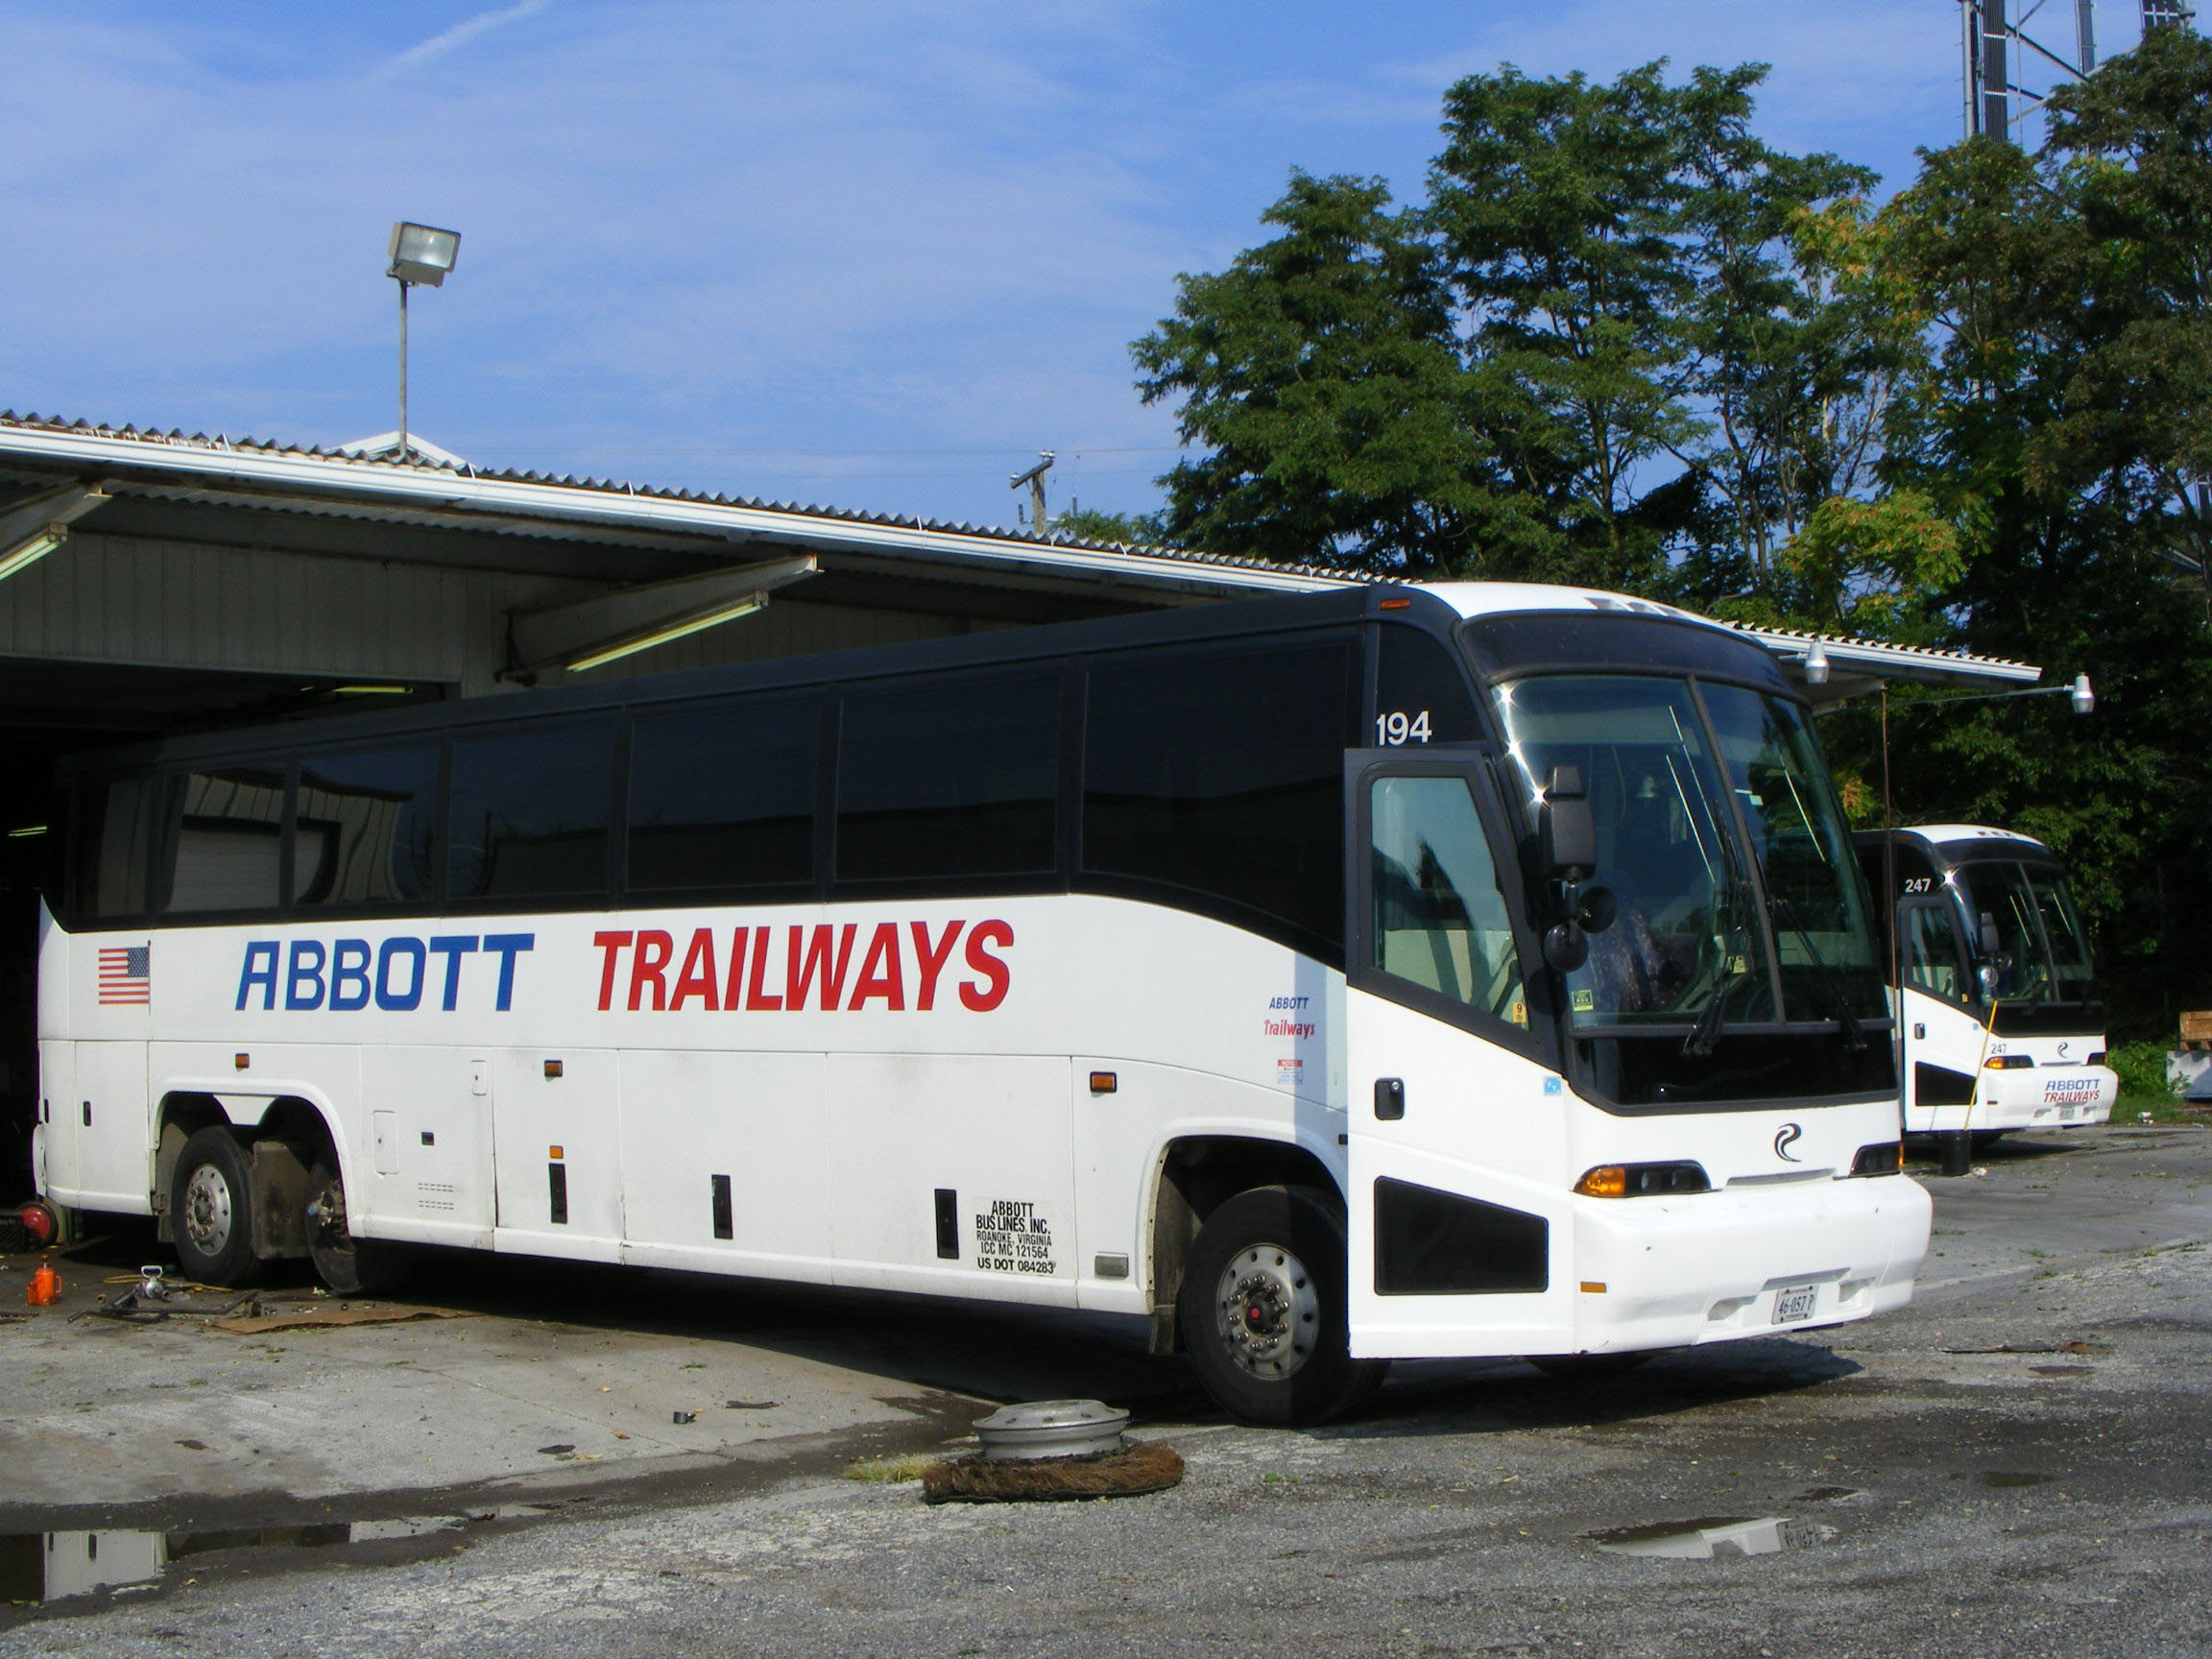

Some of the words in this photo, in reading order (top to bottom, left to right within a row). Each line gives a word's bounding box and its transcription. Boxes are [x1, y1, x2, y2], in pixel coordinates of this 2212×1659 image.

[1376, 710, 1432, 746] 194
[1905, 878, 1932, 893] 247
[235, 933, 535, 1012] ABBOTT
[593, 919, 1015, 1013] TRAILWAYS
[1268, 997, 1310, 1010] ABBOTT
[1263, 1019, 1315, 1040] Trailways
[1991, 1043, 2008, 1055] 247
[2045, 1079, 2101, 1091] ABBOTT
[2044, 1091, 2100, 1103] TRAILWAYS
[992, 1200, 1034, 1217] ABBOTT
[975, 1214, 996, 1230] BUS
[1030, 1218, 1051, 1234] INC.
[976, 1230, 1014, 1244] ROANOKE,
[1018, 1234, 1051, 1246] VIRGINIA
[980, 1241, 996, 1255] ICC
[998, 1243, 1013, 1257] MC
[1016, 1245, 1049, 1260] 121564
[977, 1257, 992, 1269] US
[994, 1258, 1015, 1272] DOT
[1017, 1260, 1054, 1274] 084283
